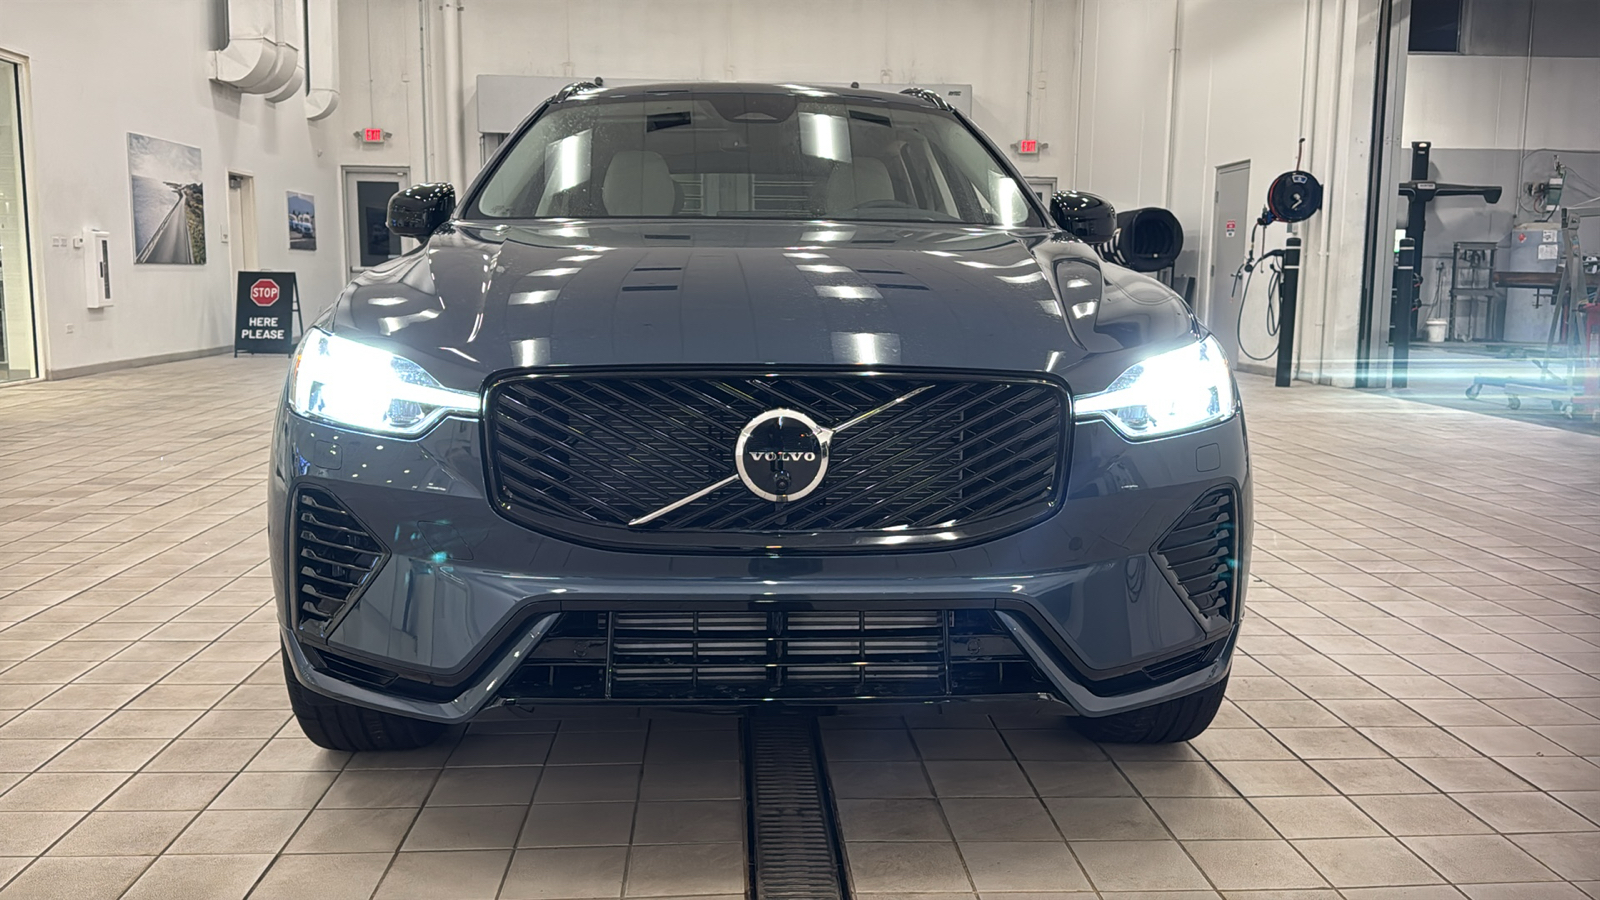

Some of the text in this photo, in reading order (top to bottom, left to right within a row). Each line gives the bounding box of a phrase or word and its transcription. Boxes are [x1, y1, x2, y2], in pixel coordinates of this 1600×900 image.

[252, 287, 278, 298] STOP
[249, 317, 279, 327] HERE
[241, 329, 285, 340] PLEASE
[749, 451, 816, 461] VOLVO
